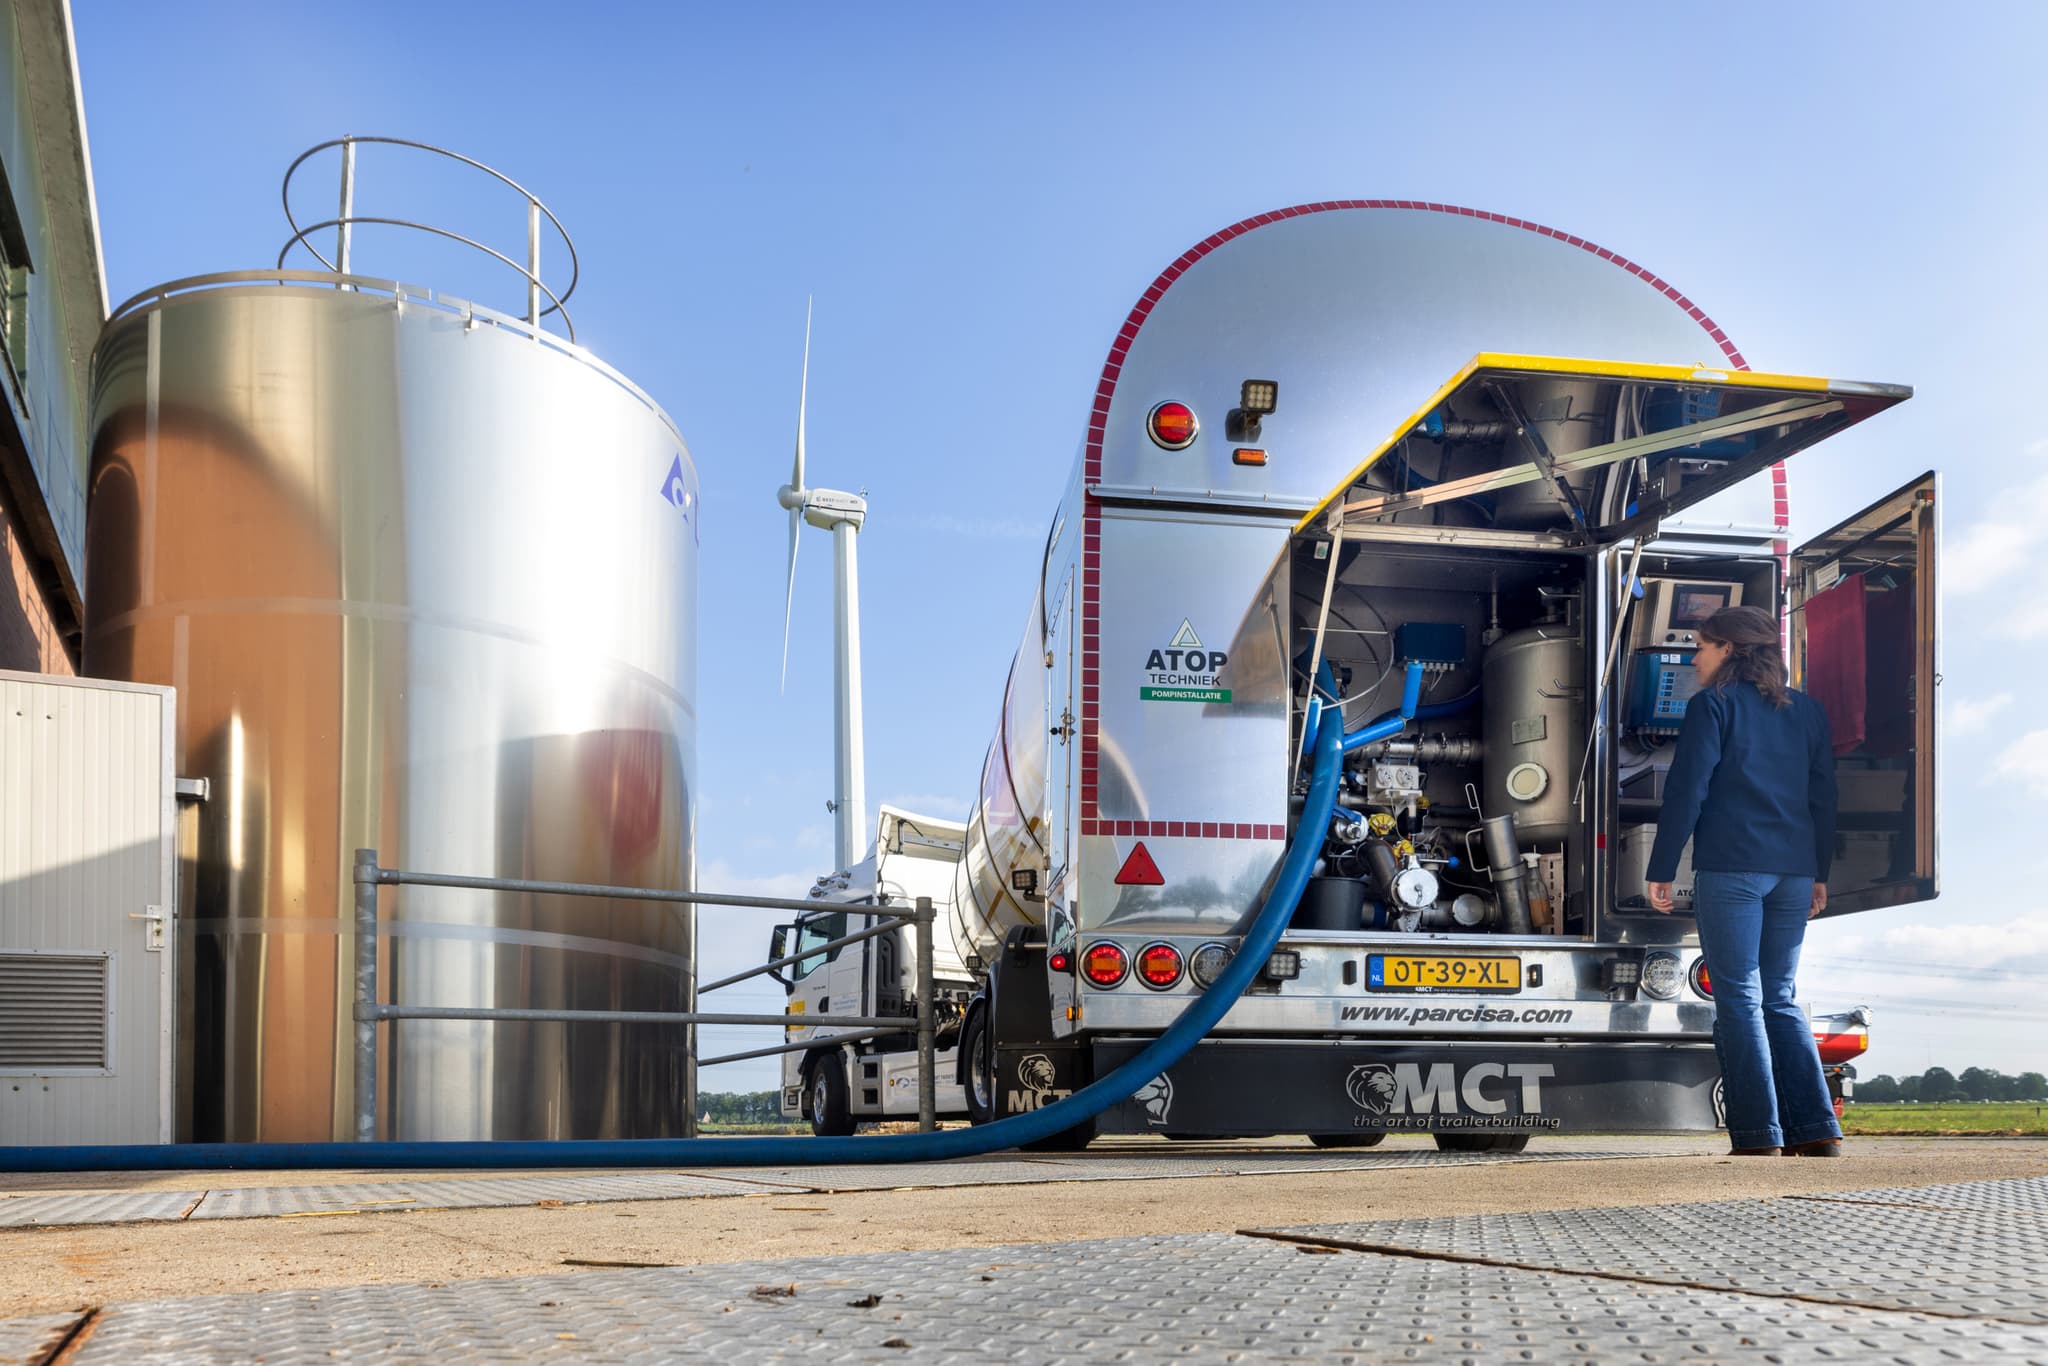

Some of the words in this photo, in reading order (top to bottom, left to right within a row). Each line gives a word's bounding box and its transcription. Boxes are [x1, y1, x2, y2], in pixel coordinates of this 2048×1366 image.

[1145, 649, 1228, 672] ATOP
[1150, 673, 1221, 686] TECHNIEK
[1151, 690, 1222, 700] POMPINSTALLATIE
[1371, 974, 1383, 982] NL
[1394, 960, 1509, 984] OT-39-XL
[1341, 1005, 1573, 1026] www.parcisa.com
[1389, 1062, 1556, 1115] MCT
[1354, 1115, 1380, 1127] the
[1386, 1115, 1411, 1127] art
[1416, 1115, 1434, 1127] of
[1439, 1115, 1561, 1129] trailerbuilding
